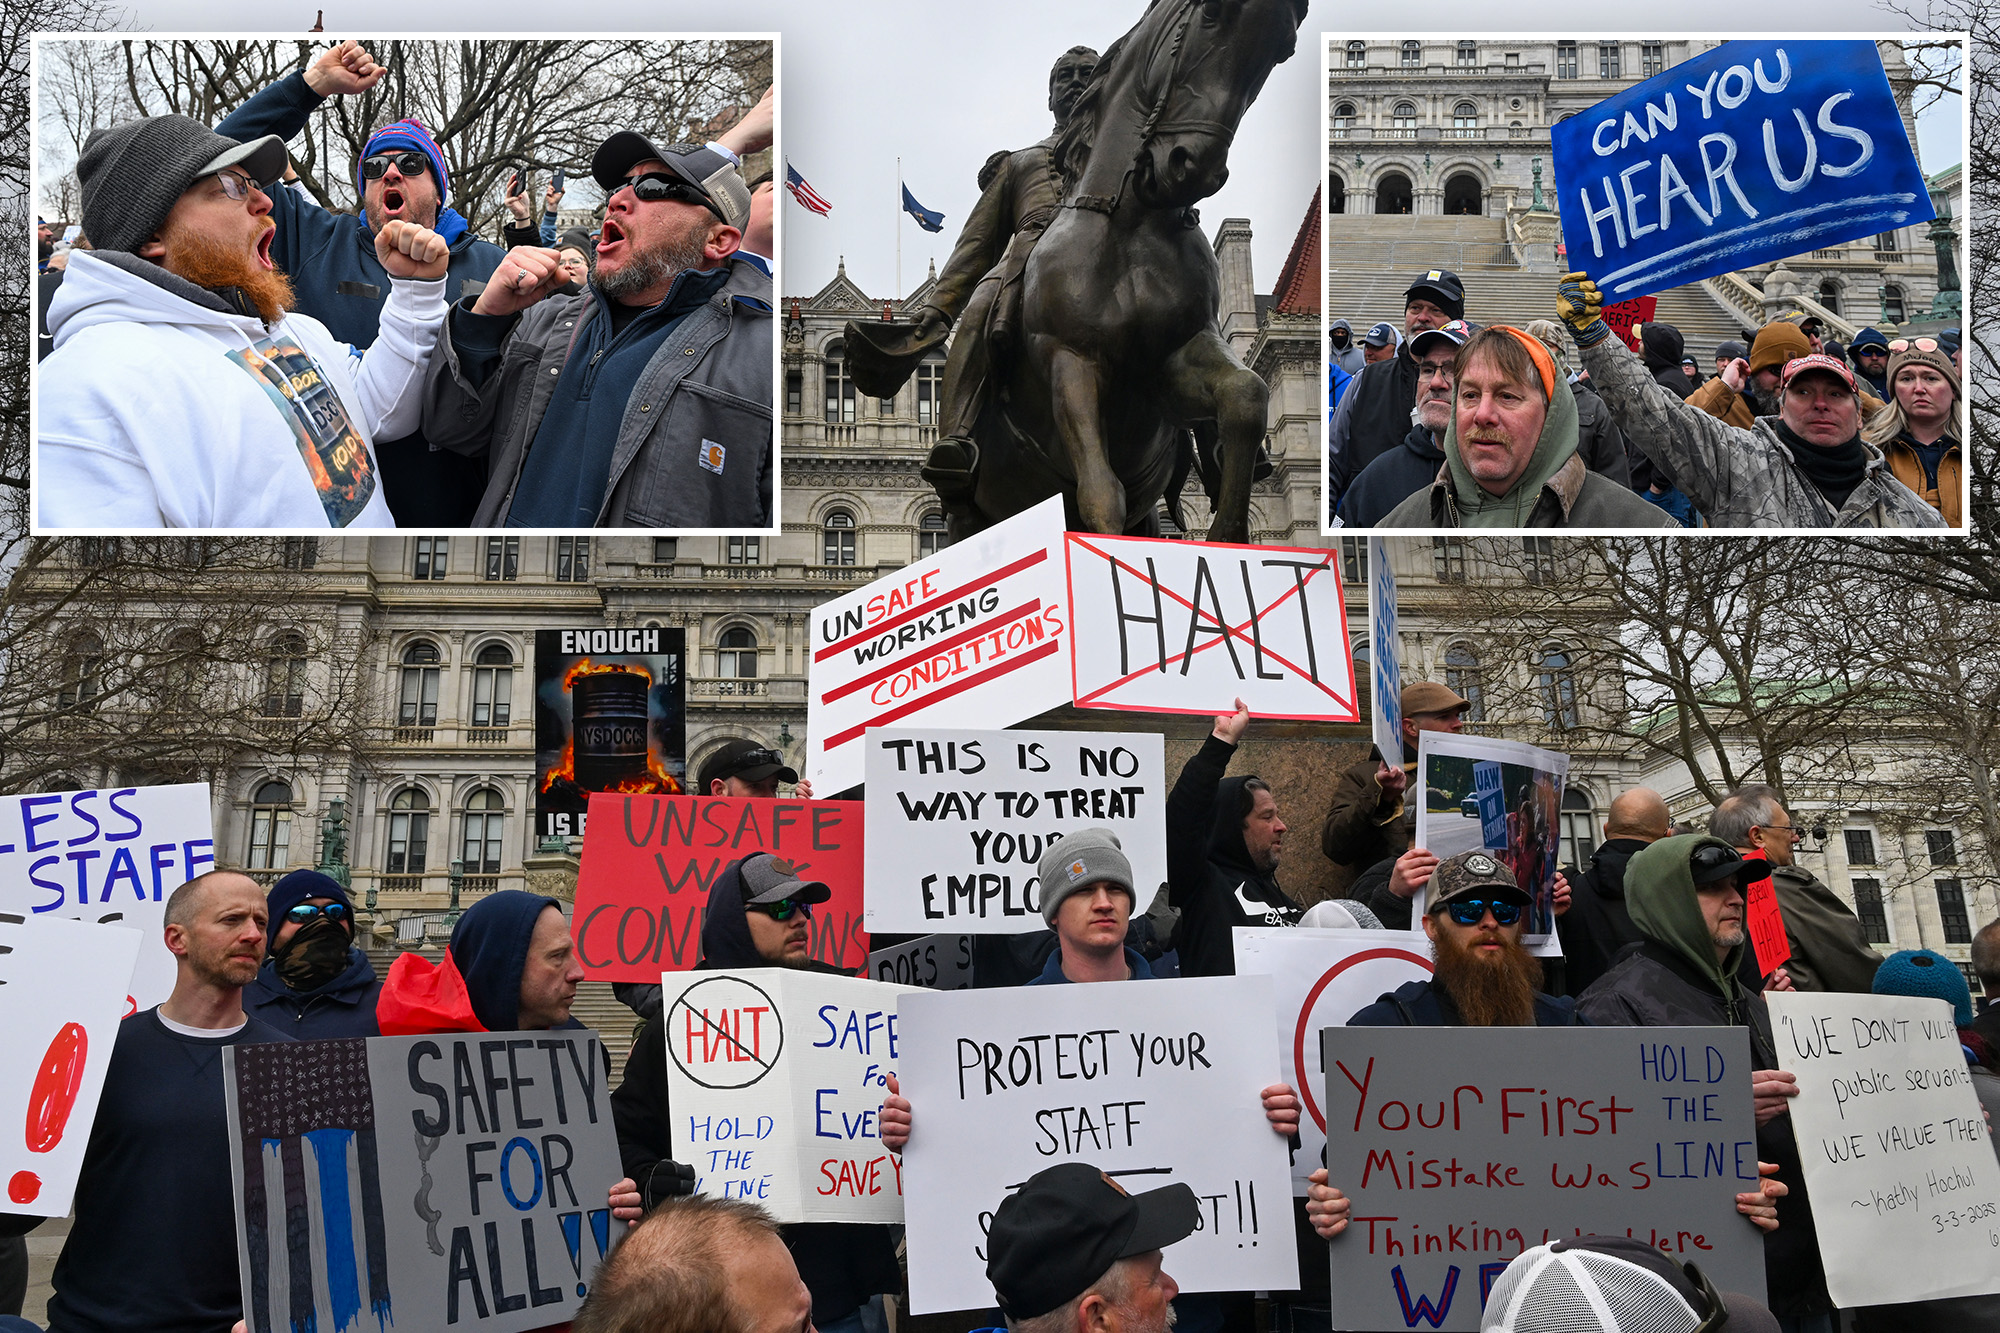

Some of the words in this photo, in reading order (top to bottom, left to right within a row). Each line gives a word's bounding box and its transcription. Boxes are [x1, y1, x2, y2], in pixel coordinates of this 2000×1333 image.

[1591, 92, 1677, 156] CAN
[1686, 48, 1791, 119] YOU
[1581, 132, 1760, 257] HEAR
[1762, 89, 1874, 194] US
[823, 568, 941, 643] UNSAFE
[1110, 556, 1330, 684] HALT
[561, 630, 659, 654] ENOUGH
[854, 588, 999, 665] WORKING
[871, 604, 1064, 706] CONDITIONS
[578, 727, 645, 745] NYSDOCCS
[882, 739, 986, 775] THIS
[1017, 743, 1051, 773] IS
[1079, 746, 1139, 778] NO
[1475, 766, 1499, 792] UAW
[623, 797, 843, 851] UNSAFE
[896, 791, 987, 821] WAY
[994, 791, 1039, 819] TO
[1044, 786, 1145, 819] TREAT
[1487, 797, 1497, 820] ON
[547, 813, 571, 836] IS
[1484, 814, 1505, 844] STRIKE
[878, 945, 938, 987] DOES
[686, 1006, 769, 1064] HALT
[1852, 1017, 1910, 1049] DON'T
[957, 1030, 1120, 1100] PROTECT
[1130, 1032, 1212, 1077] YOUR
[1640, 1044, 1725, 1084] HOLD
[408, 1038, 598, 1138] SAFETY
[1336, 1056, 1484, 1132] Your
[1501, 1085, 1634, 1137] First
[1662, 1094, 1722, 1122] THE
[1832, 1068, 1896, 1120] public
[690, 1115, 774, 1142] HOLD
[1035, 1101, 1146, 1156] STAFF
[1823, 1134, 1866, 1164] WE
[1877, 1124, 1936, 1154] VALUE
[466, 1134, 579, 1216] FOR
[707, 1150, 755, 1173] THE
[817, 1156, 886, 1198] SAVE
[1361, 1149, 1525, 1190] Mistake
[1657, 1141, 1757, 1180] LINE
[1926, 1166, 1975, 1198] Hochul
[1353, 1216, 1525, 1261] Thinking
[1932, 1202, 1997, 1234] 3-3-2025
